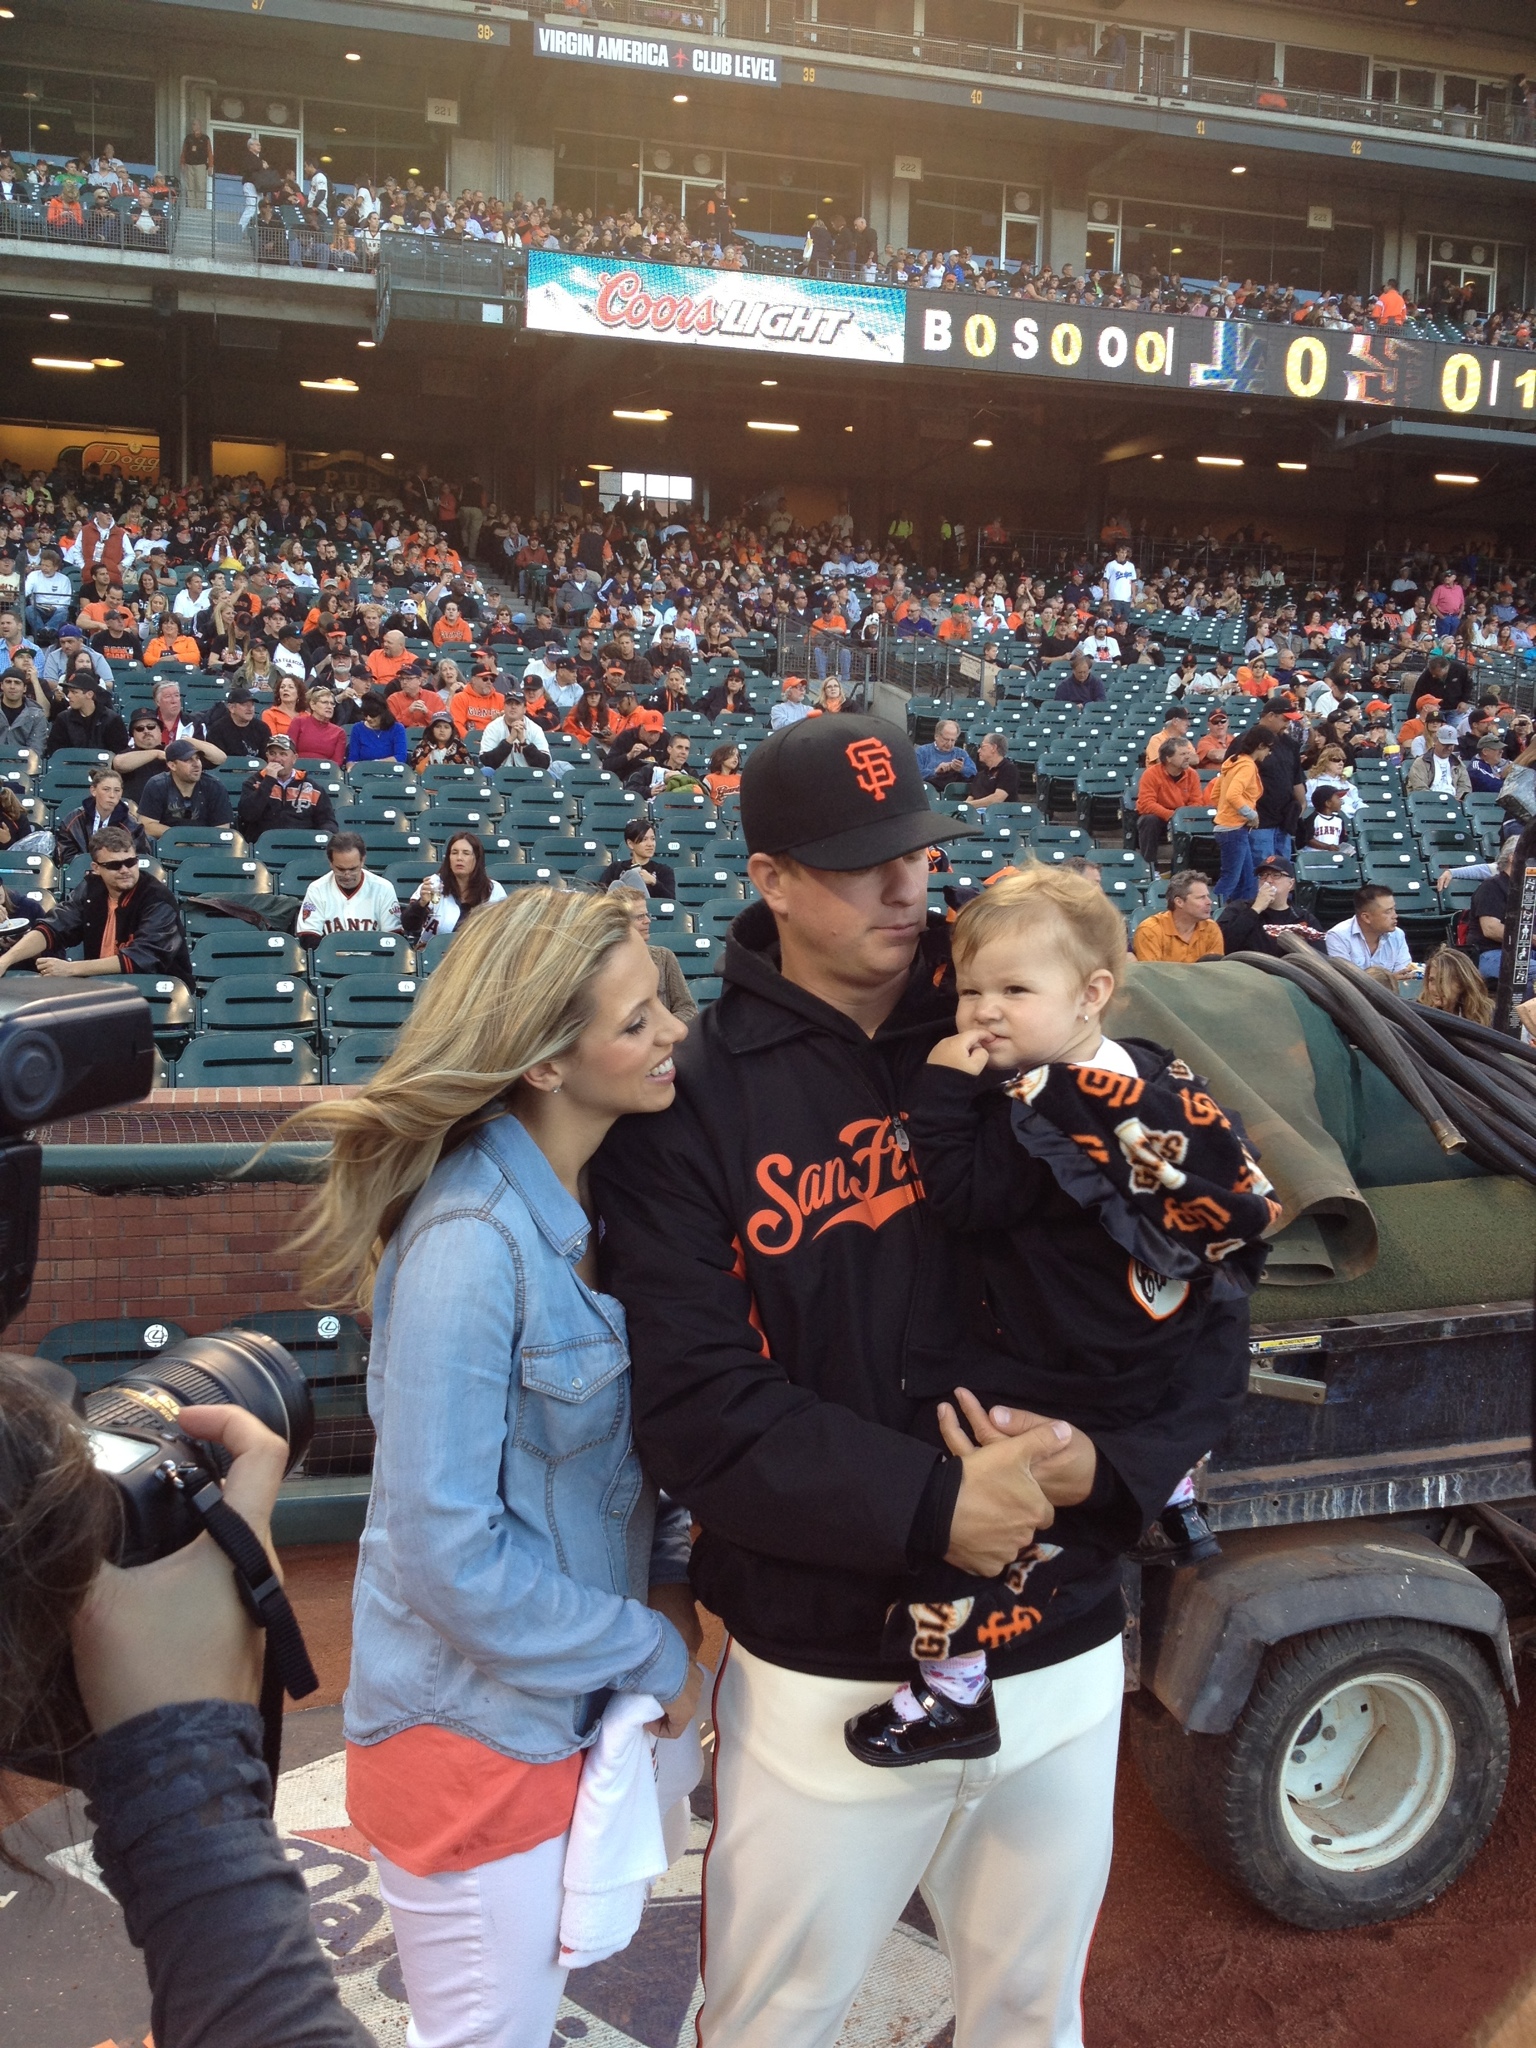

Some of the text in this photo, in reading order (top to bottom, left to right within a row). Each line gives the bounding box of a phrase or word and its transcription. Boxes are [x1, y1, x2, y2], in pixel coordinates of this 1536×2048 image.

[538, 28, 777, 82] VIRGIN AMERICA CLUB LEVEL
[970, 89, 982, 104] 40
[434, 105, 451, 117] 221
[1196, 120, 1205, 135] 41
[1350, 140, 1362, 155] 42
[900, 162, 916, 173] 222
[1313, 212, 1328, 223] 223
[596, 270, 855, 344] Coors LIGHT
[923, 309, 952, 351] B
[1012, 317, 1039, 360] S
[845, 737, 896, 801] SF
[320, 917, 378, 936] IANTS
[747, 1153, 851, 1255] San
